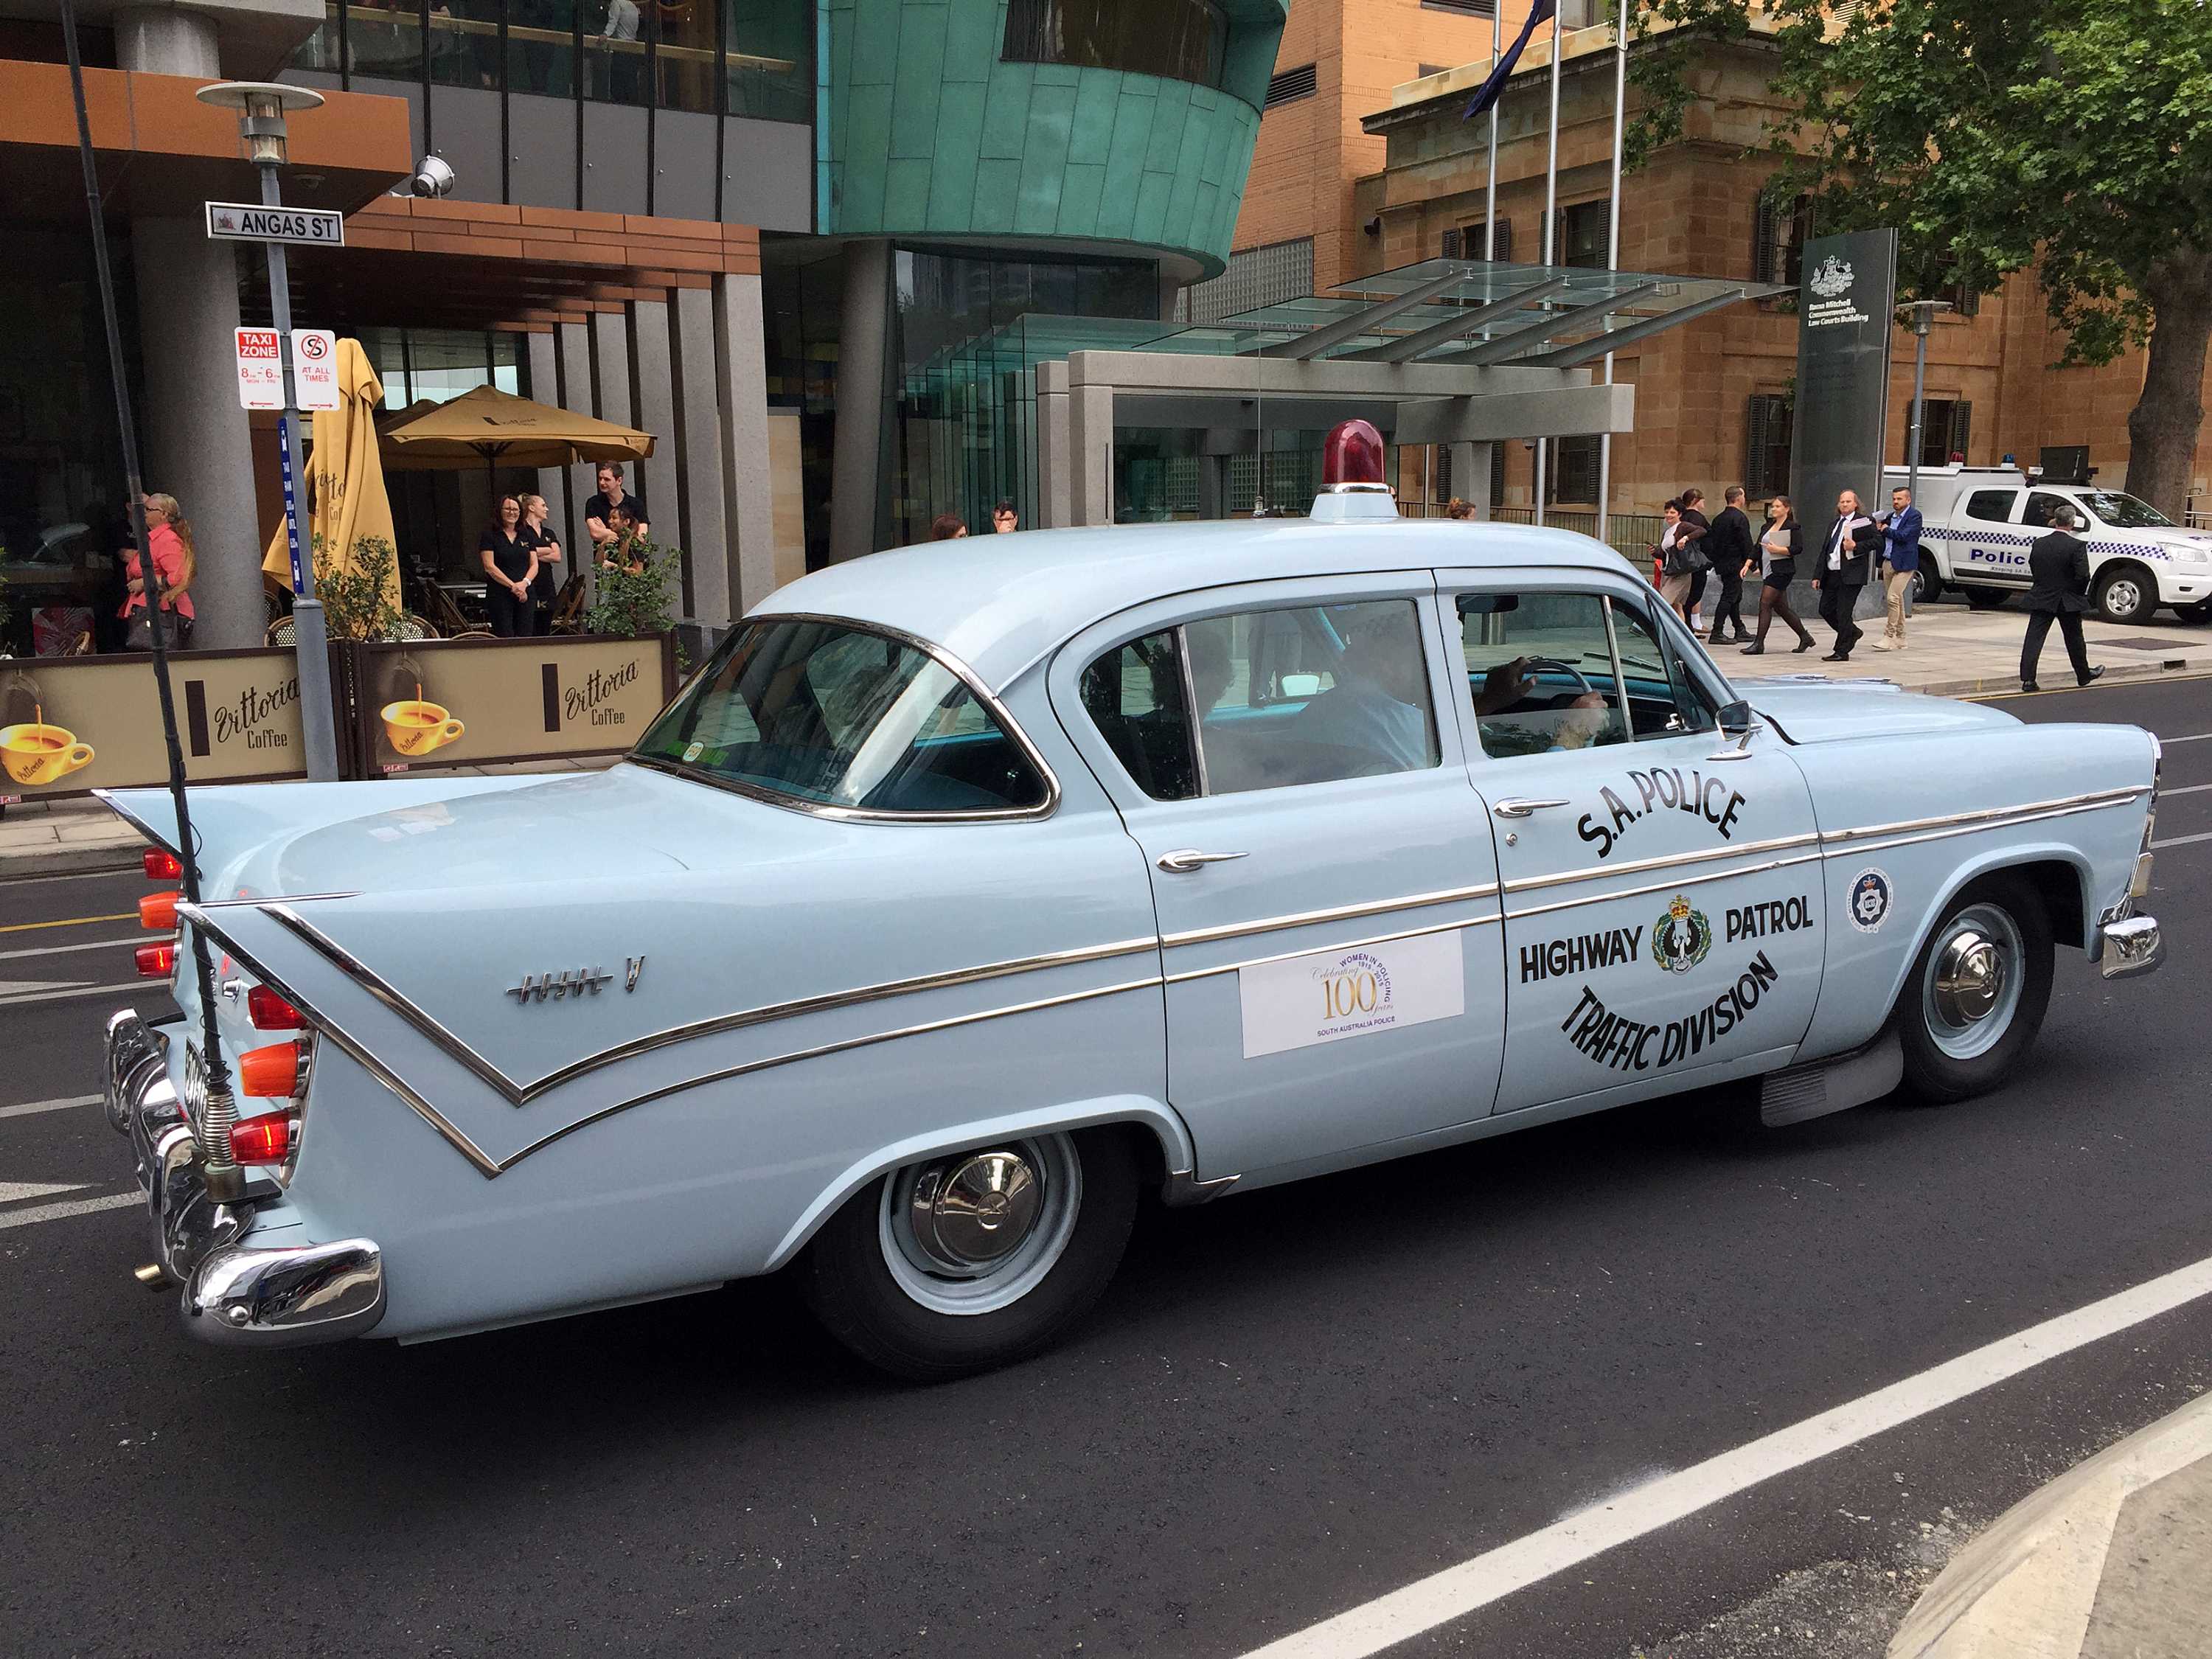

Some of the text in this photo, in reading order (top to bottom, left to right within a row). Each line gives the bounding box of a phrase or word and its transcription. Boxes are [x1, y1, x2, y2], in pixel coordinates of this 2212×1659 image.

[241, 212, 333, 237] ANGAS ST
[1808, 307, 1857, 319] Commonwealth
[1826, 299, 1851, 308] Mitchell
[1820, 317, 1840, 325] Courts
[1840, 314, 1869, 323] Building
[243, 334, 272, 345] TAXI
[241, 346, 277, 358] ZONE
[305, 375, 330, 383] TIMES
[1970, 549, 2025, 565] Polic
[565, 661, 639, 720] Vittoria
[215, 678, 301, 743] Vittoria
[591, 708, 625, 726] Coffee
[247, 728, 288, 749] Coffee
[1520, 925, 1644, 983] HIGHWAY
[1726, 896, 1813, 942] PATROL
[1310, 967, 1360, 980] Celebrating
[1340, 953, 1391, 1003] WOMEN IN POLICING
[1322, 971, 1377, 1020] 100
[1562, 950, 1778, 1071] TRAFFIC DIVISION
[1317, 1016, 1395, 1037] SOUTH AUSTRALIA POLICE
